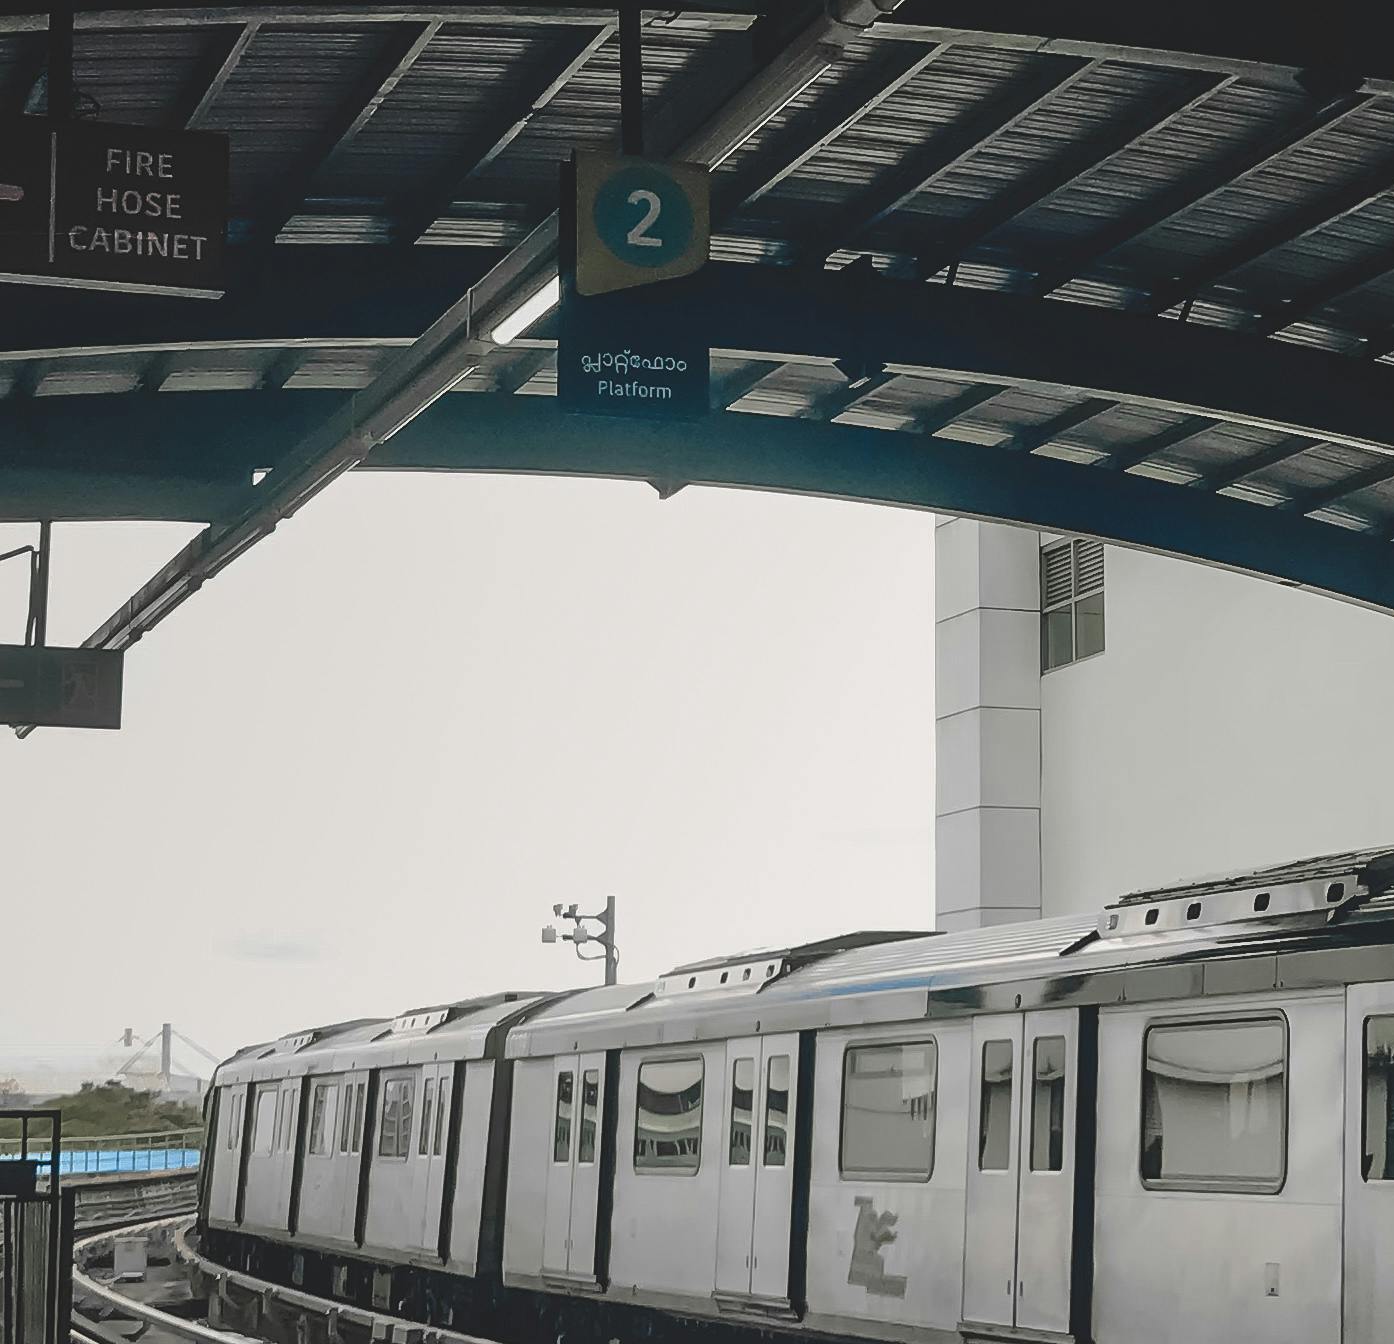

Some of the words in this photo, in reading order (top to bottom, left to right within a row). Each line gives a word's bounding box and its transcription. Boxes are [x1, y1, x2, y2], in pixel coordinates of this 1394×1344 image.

[107, 148, 174, 178] FIRE
[97, 187, 182, 219] HOSE
[627, 189, 662, 247] 2
[69, 225, 207, 260] CABINET
[598, 380, 672, 399] Platform
